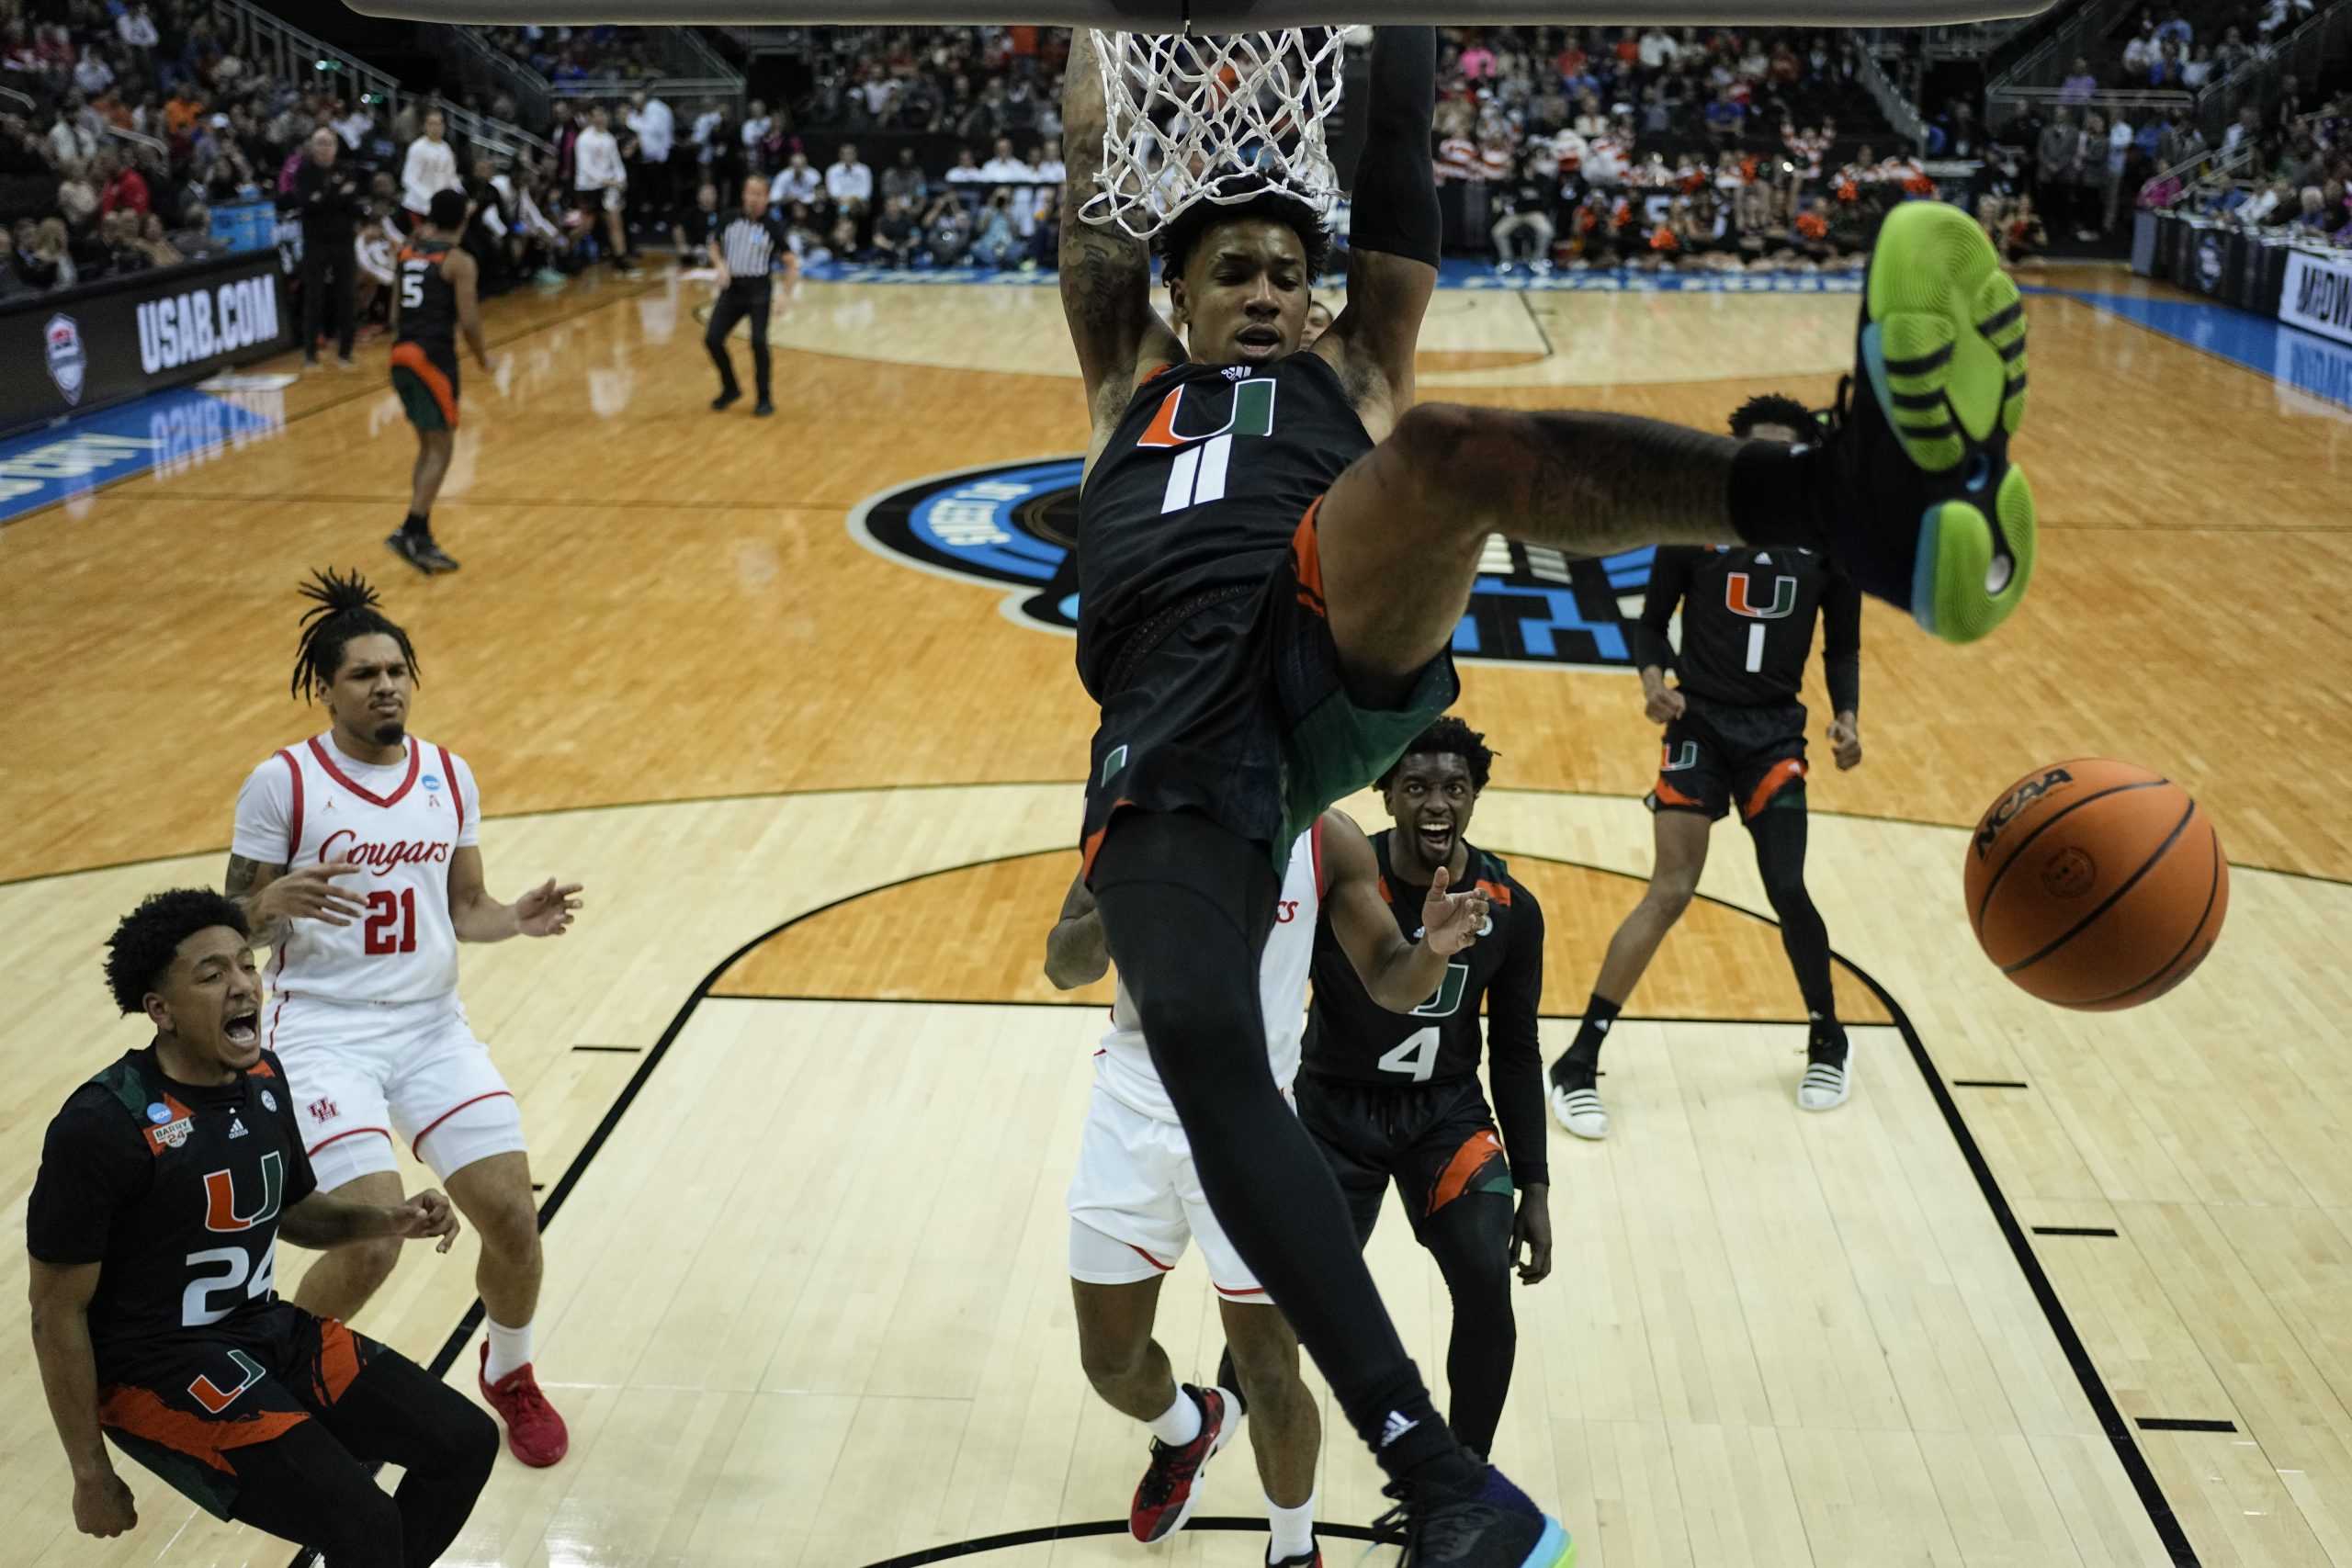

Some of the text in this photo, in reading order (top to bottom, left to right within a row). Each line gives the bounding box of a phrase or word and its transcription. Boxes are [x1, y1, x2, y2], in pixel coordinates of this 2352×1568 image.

[137, 274, 278, 374] USAB.COM
[401, 274, 424, 308] 5
[1136, 378, 1276, 447] U
[1161, 434, 1232, 513] 11
[1725, 571, 1797, 618] U
[1746, 623, 1765, 672] 1
[1975, 769, 2073, 860] NCAA
[319, 829, 448, 876] Cougars
[365, 886, 416, 955] 21
[1377, 1026, 1440, 1083] 4
[155, 1120, 187, 1138] BARRY
[166, 1130, 186, 1144] 24
[203, 1151, 283, 1233] U
[182, 1225, 279, 1326] 24
[187, 1349, 266, 1415] U
